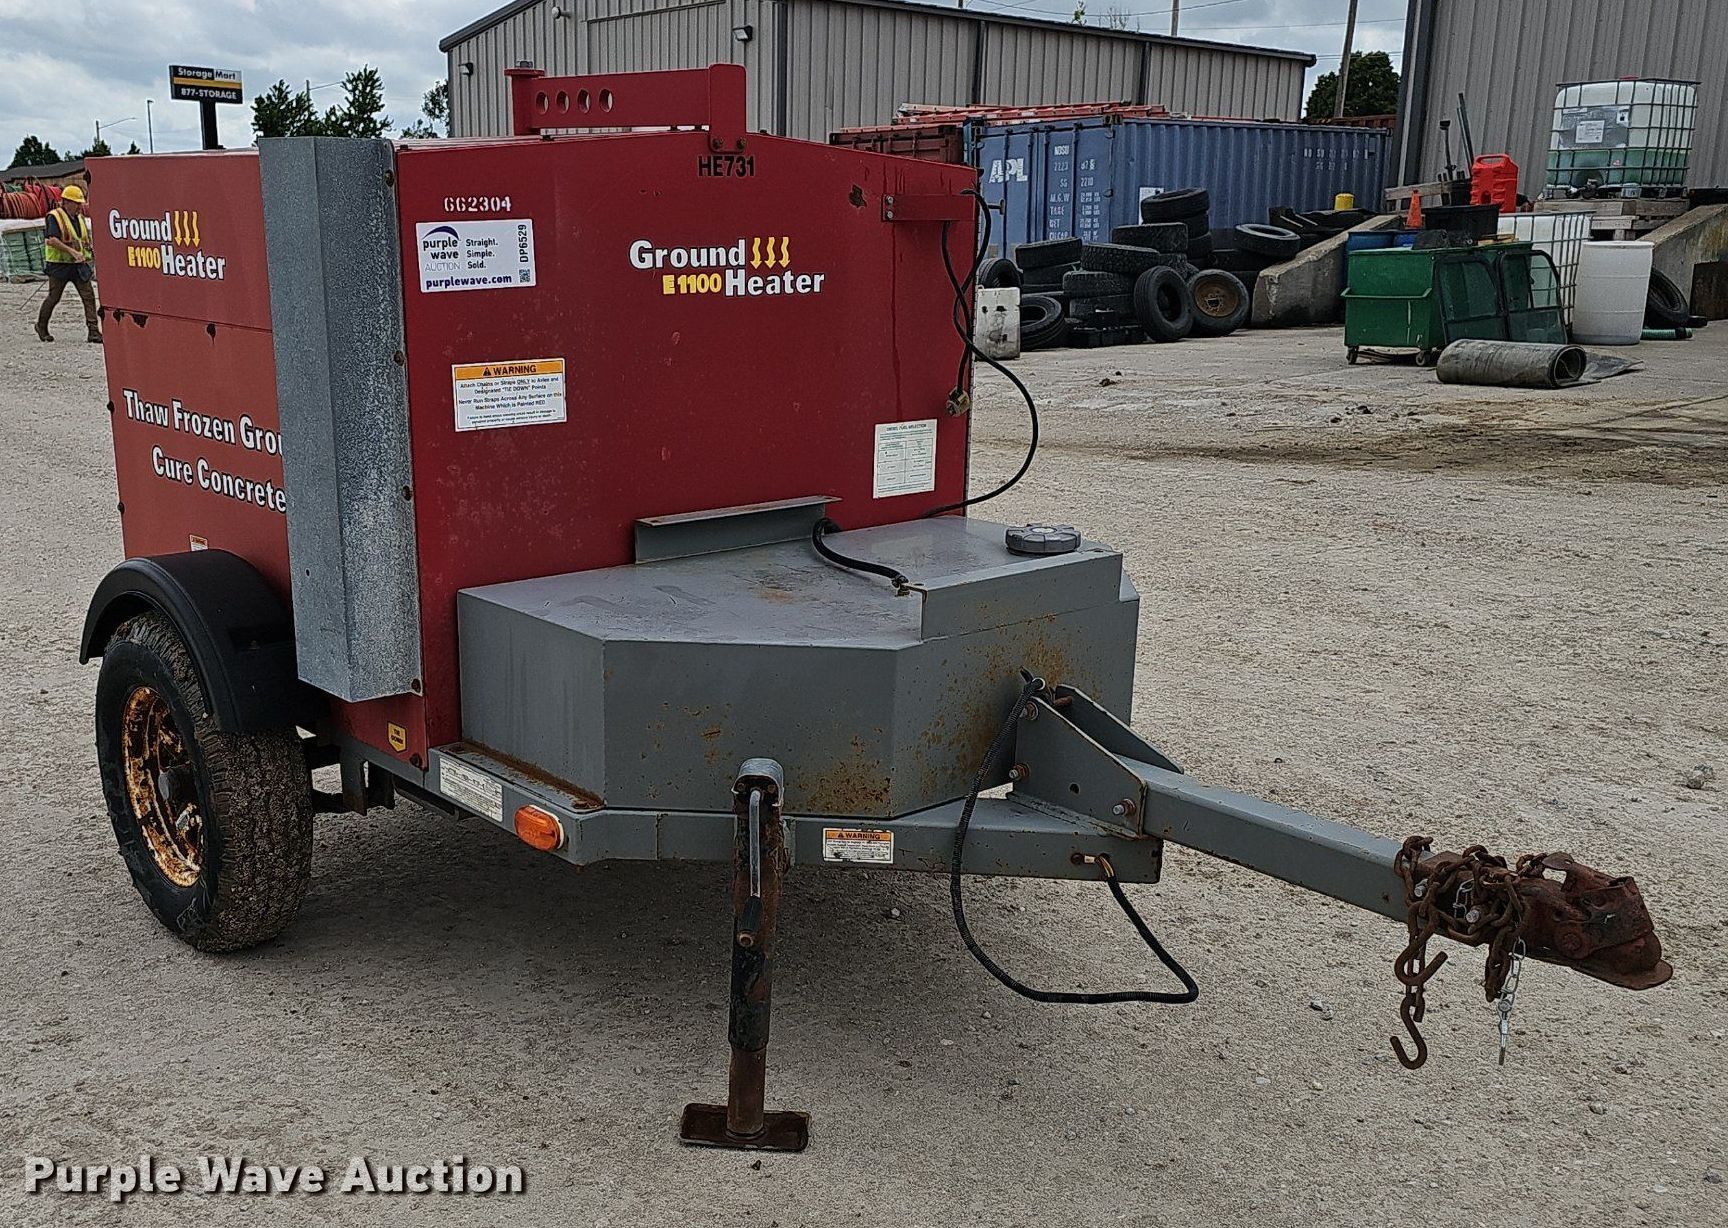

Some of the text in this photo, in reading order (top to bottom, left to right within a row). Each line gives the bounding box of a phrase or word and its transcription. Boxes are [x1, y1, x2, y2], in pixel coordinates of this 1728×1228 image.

[178, 67, 236, 80] Storage Mart
[181, 88, 237, 99] 877-STORAGE
[698, 156, 755, 177] HE731
[988, 158, 1028, 183] APL
[444, 196, 512, 212] 662304
[109, 209, 173, 242] Ground
[423, 237, 458, 252] purple
[466, 238, 498, 248] Straight.
[518, 224, 529, 262] DP6529
[430, 250, 459, 260] wave
[466, 250, 495, 259] Simple.
[629, 239, 746, 270] Ground
[128, 245, 226, 280] E1100 Heater
[425, 262, 460, 272] AUCTION
[468, 260, 486, 269] Sold.
[426, 275, 512, 290] purplewave.com
[662, 269, 825, 296] E1100 Heater
[493, 364, 537, 376] WARNING
[123, 389, 169, 427] Thaw
[172, 400, 236, 444] Frozen
[152, 446, 286, 512] Cure Concrete
